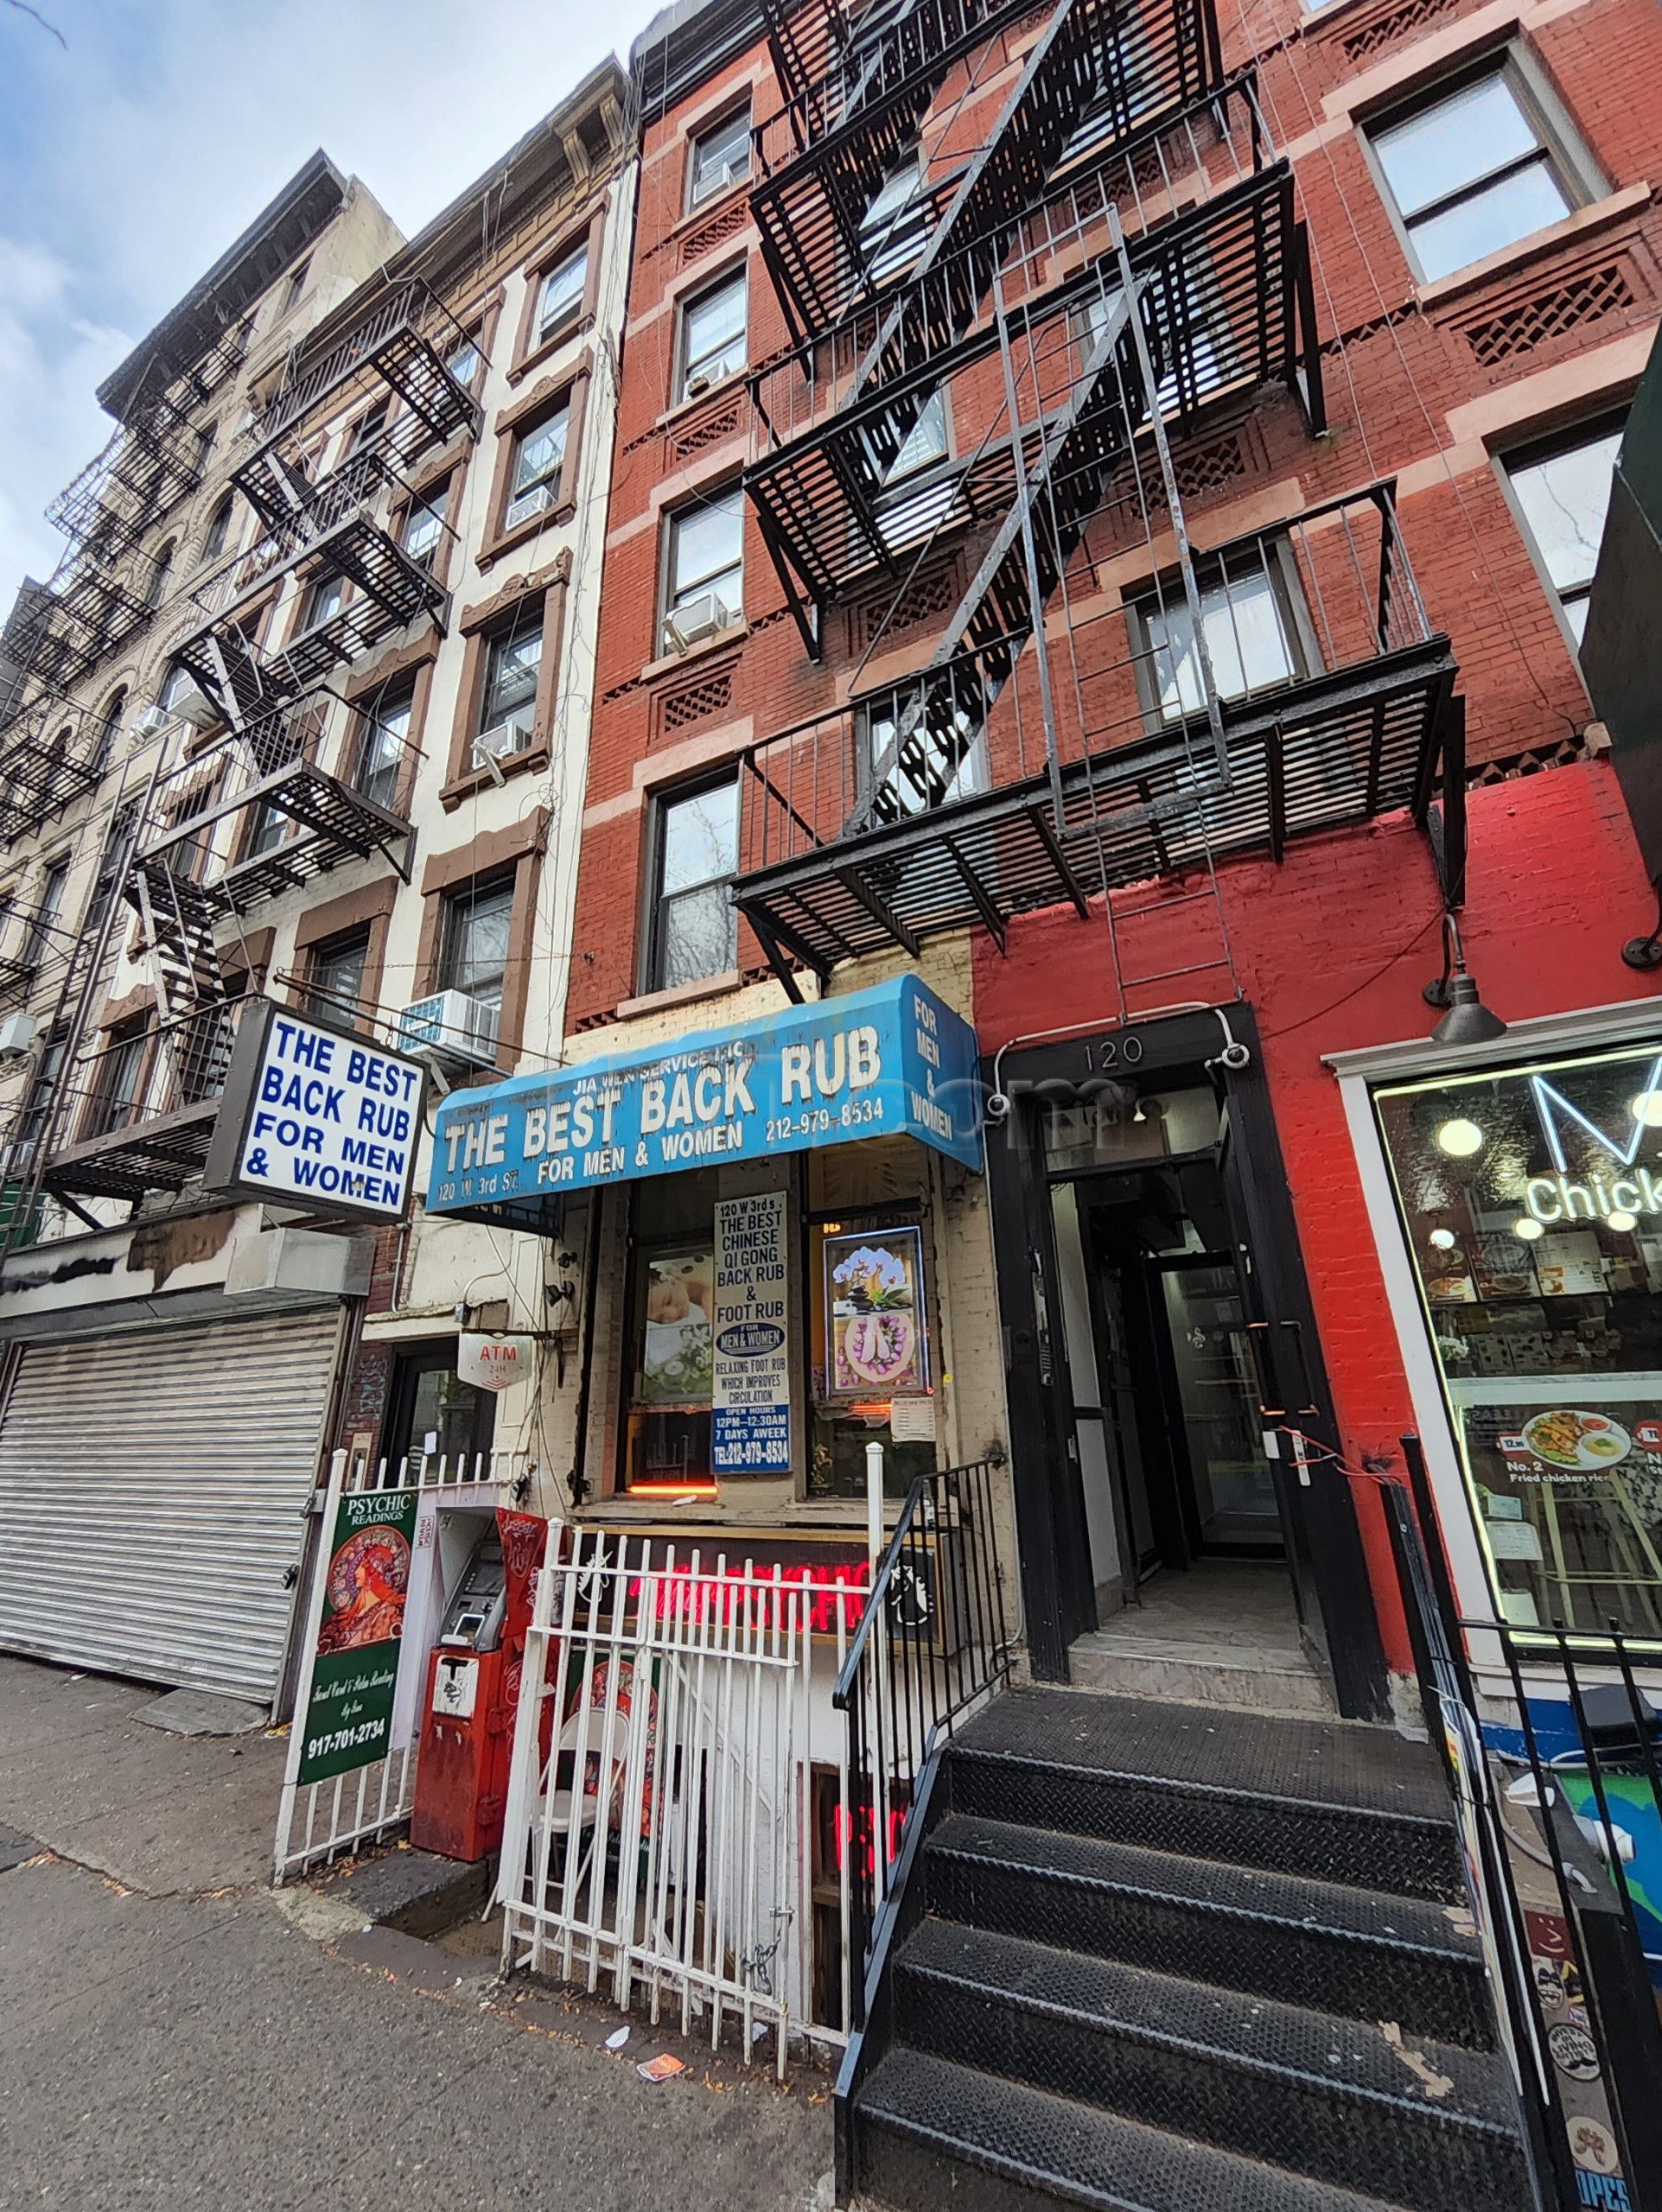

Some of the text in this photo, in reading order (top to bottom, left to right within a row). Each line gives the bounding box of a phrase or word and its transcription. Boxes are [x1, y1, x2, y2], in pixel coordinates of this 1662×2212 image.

[914, 994, 938, 1036] FOR
[916, 1027, 940, 1069] MEN
[1085, 1037, 1143, 1071] 120
[277, 1020, 417, 1102] THE BEST
[572, 1077, 597, 1096] JIA
[640, 1051, 710, 1080] SERVICE
[927, 1069, 936, 1097] &
[261, 1065, 410, 1141] BACK RUB
[445, 1114, 508, 1173] THE
[523, 1087, 621, 1159] BEST
[640, 1056, 756, 1134] BACK
[781, 1026, 882, 1104] RUB
[911, 1090, 953, 1141] WOMEN
[253, 1111, 404, 1175] FOR MEN
[538, 1097, 883, 1185] FOR MEN & WOMEN 212-979-8534
[246, 1147, 400, 1205] & WOMEN
[438, 1181, 455, 1202] 120
[478, 1177, 497, 1195] 3rd
[720, 1204, 735, 1217] 120
[739, 1201, 748, 1214] W
[750, 1198, 767, 1212] 3rd
[719, 1211, 782, 1235] THE BEST
[723, 1229, 779, 1251] CHINESE
[724, 1247, 778, 1268] QI GONG
[717, 1264, 784, 1287] BACK RUB
[746, 1286, 756, 1301] &
[717, 1301, 784, 1323] FOOT RUB
[721, 1331, 780, 1349] MEN & WOMEN
[480, 1345, 517, 1361] ATM
[715, 1357, 786, 1375] RELAXING FOOT RUB
[721, 1374, 781, 1390] WHICH IMPROVES
[729, 1389, 773, 1404] CIRCULATION
[725, 1408, 746, 1416] OPEN
[716, 1431, 722, 1440] 7
[724, 1429, 748, 1440] DAYS
[1506, 1461, 1544, 1471] No. 2
[1509, 1473, 1540, 1483] Fried
[1542, 1473, 1586, 1483] chicken
[347, 1494, 411, 1516] PSYCHIC
[351, 1510, 404, 1526] READINGS
[308, 1718, 385, 1759] 917-701-2734
